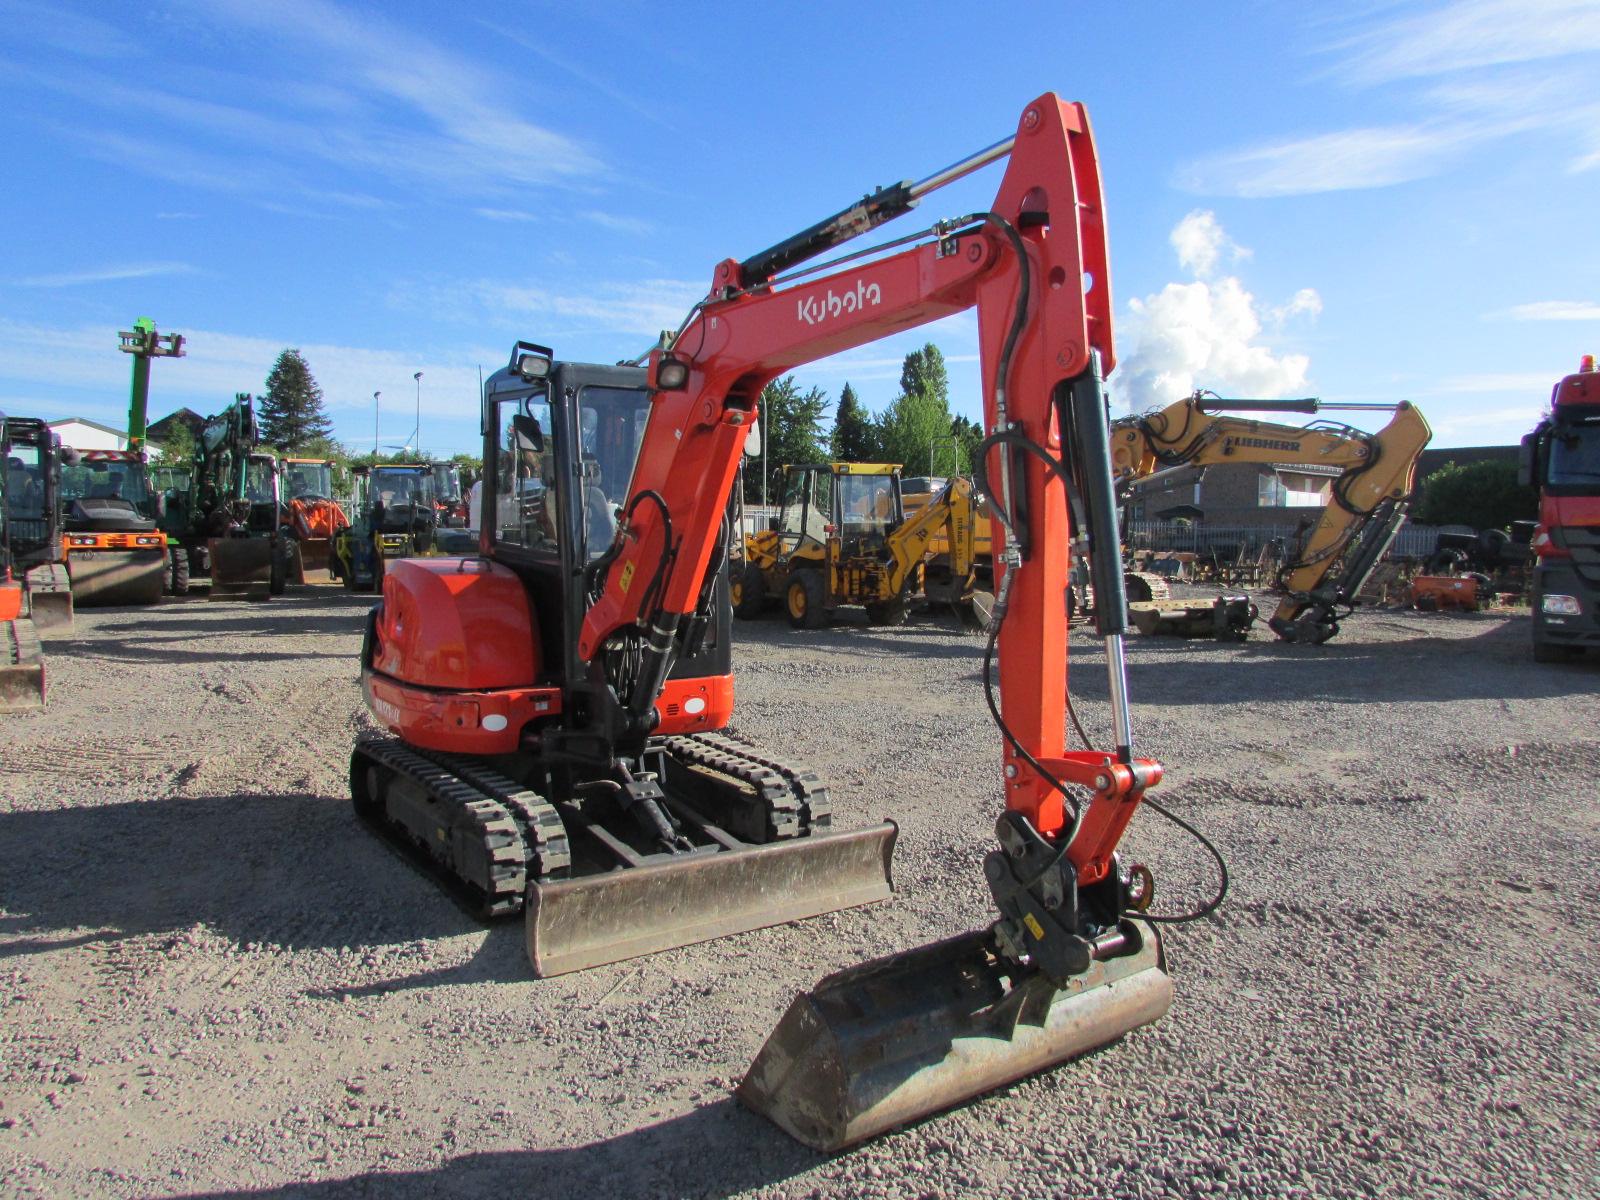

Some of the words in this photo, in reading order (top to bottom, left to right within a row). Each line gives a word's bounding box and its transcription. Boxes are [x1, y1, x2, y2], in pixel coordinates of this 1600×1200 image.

[797, 279, 881, 325] Kubota
[1234, 436, 1301, 452] LIEBHERR
[915, 528, 929, 542] JCB
